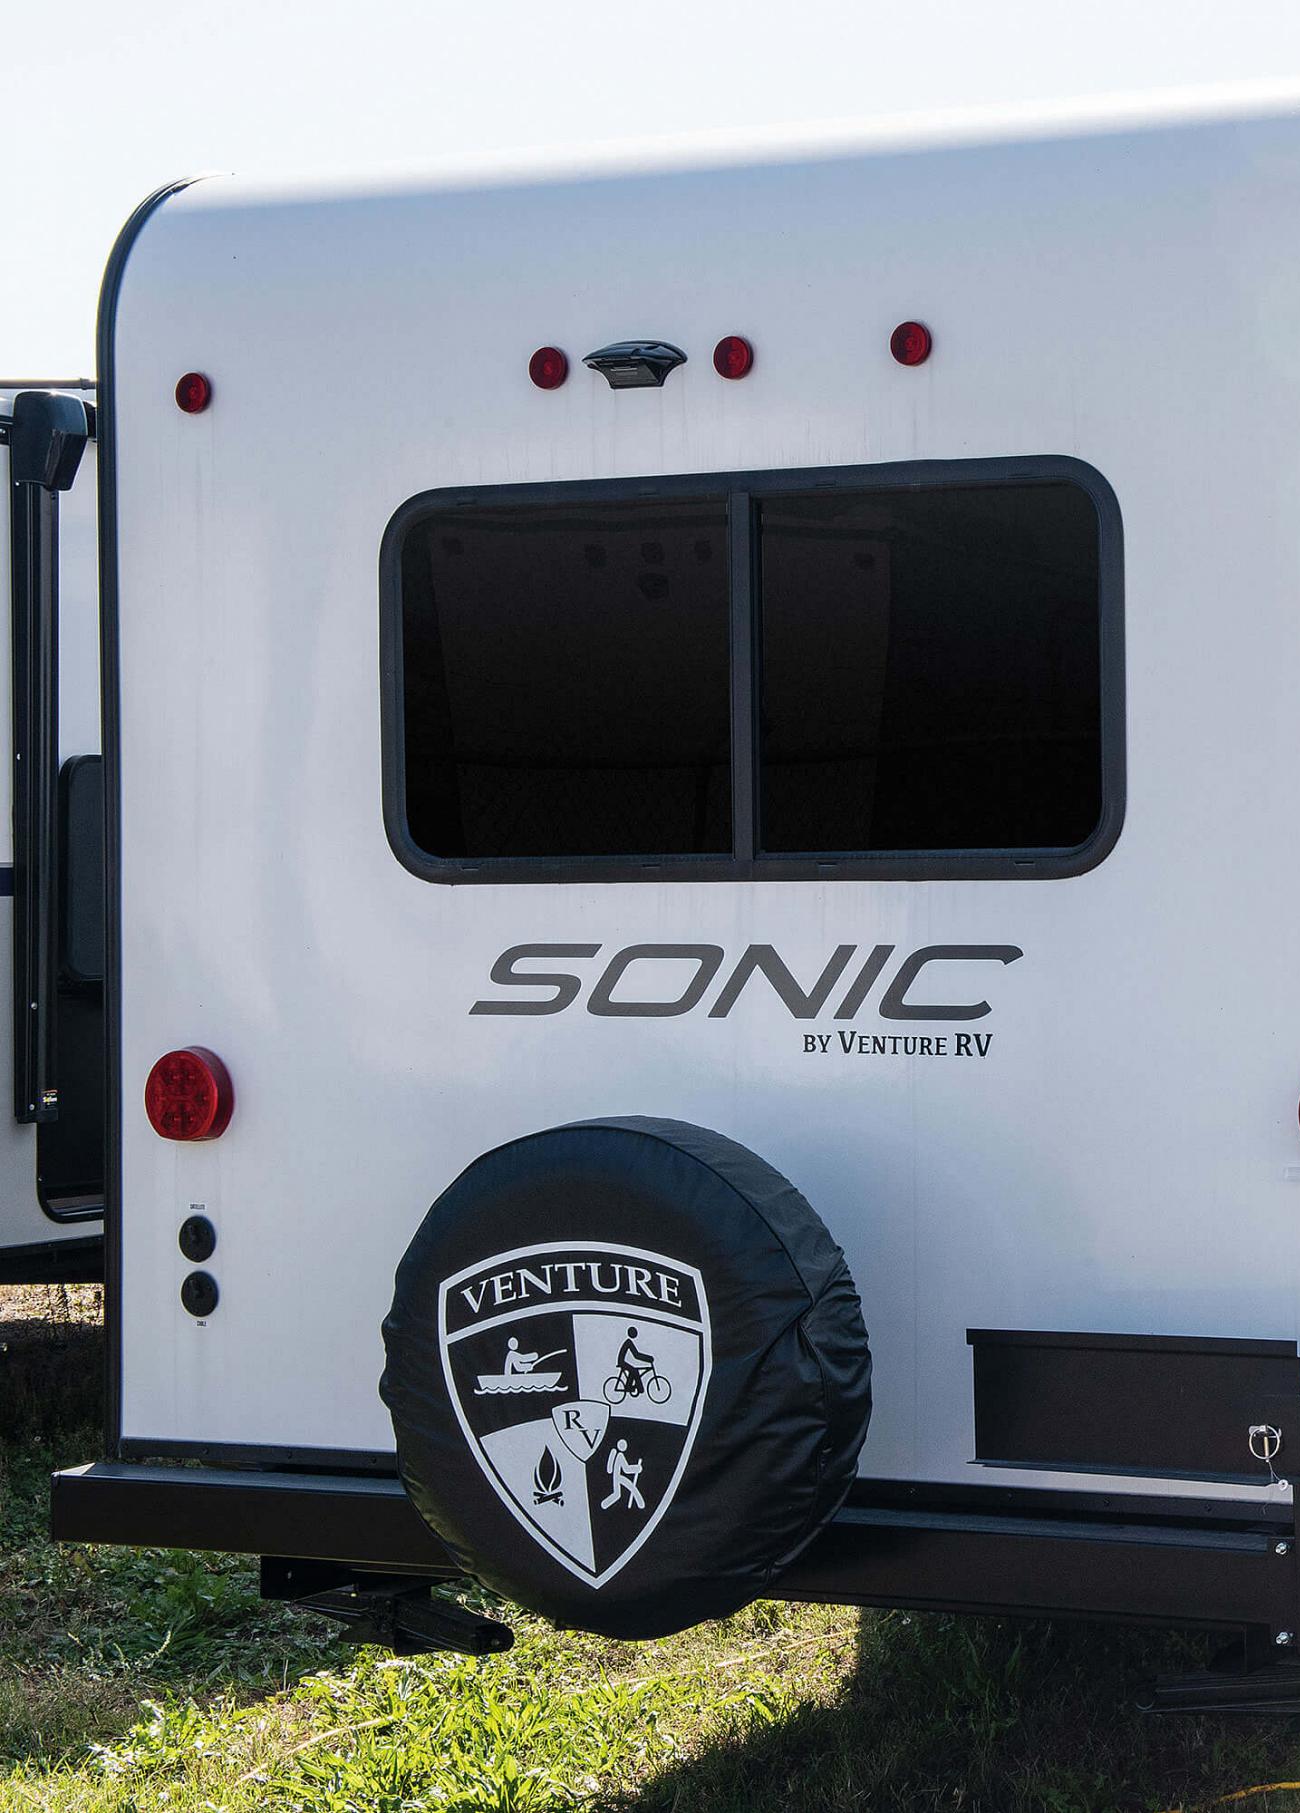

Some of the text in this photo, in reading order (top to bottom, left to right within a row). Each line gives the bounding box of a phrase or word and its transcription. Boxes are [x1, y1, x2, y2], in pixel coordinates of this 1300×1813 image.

[468, 943, 1024, 1021] SONIC
[803, 1031, 994, 1057] BY VENTURE RV
[460, 1262, 683, 1315] VENTURE
